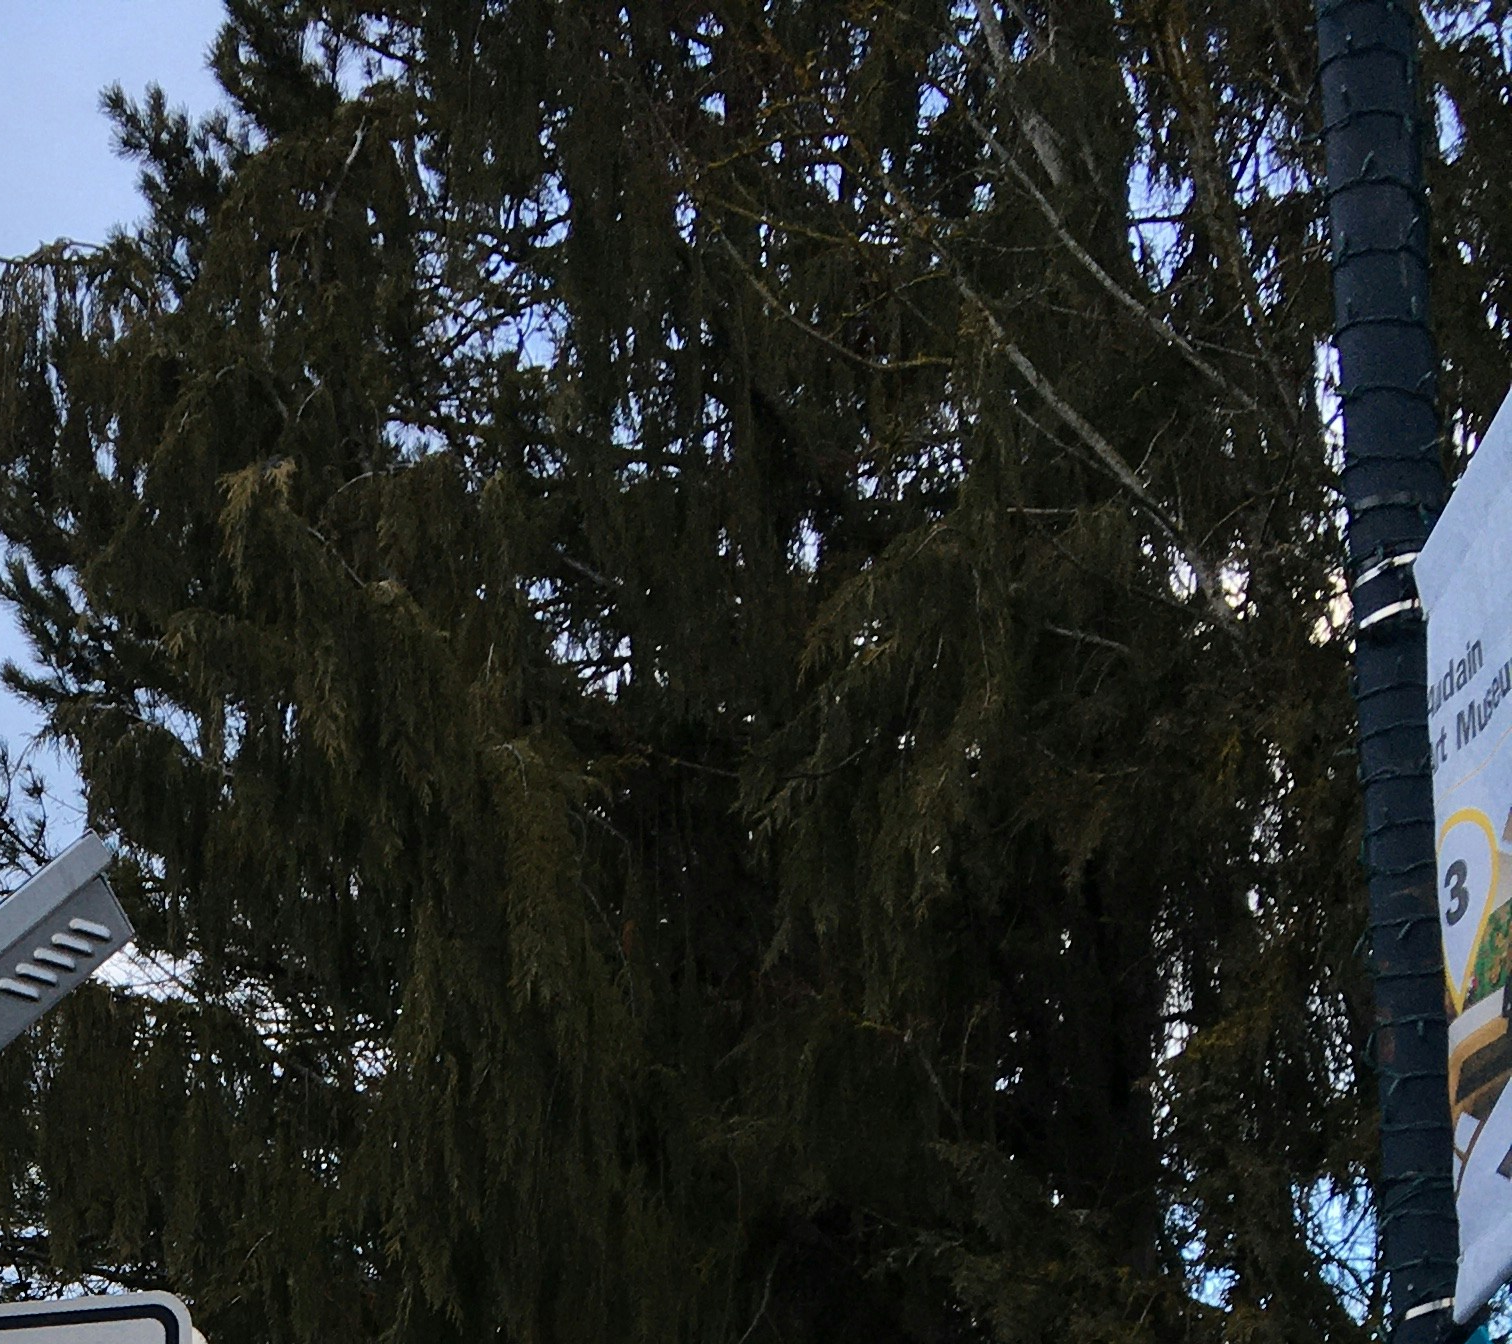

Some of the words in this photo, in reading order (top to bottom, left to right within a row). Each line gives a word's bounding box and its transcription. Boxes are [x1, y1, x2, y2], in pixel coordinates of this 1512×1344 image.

[1428, 639, 1483, 718] udain
[1457, 656, 1512, 751] Museu
[1444, 858, 1470, 927] 3
